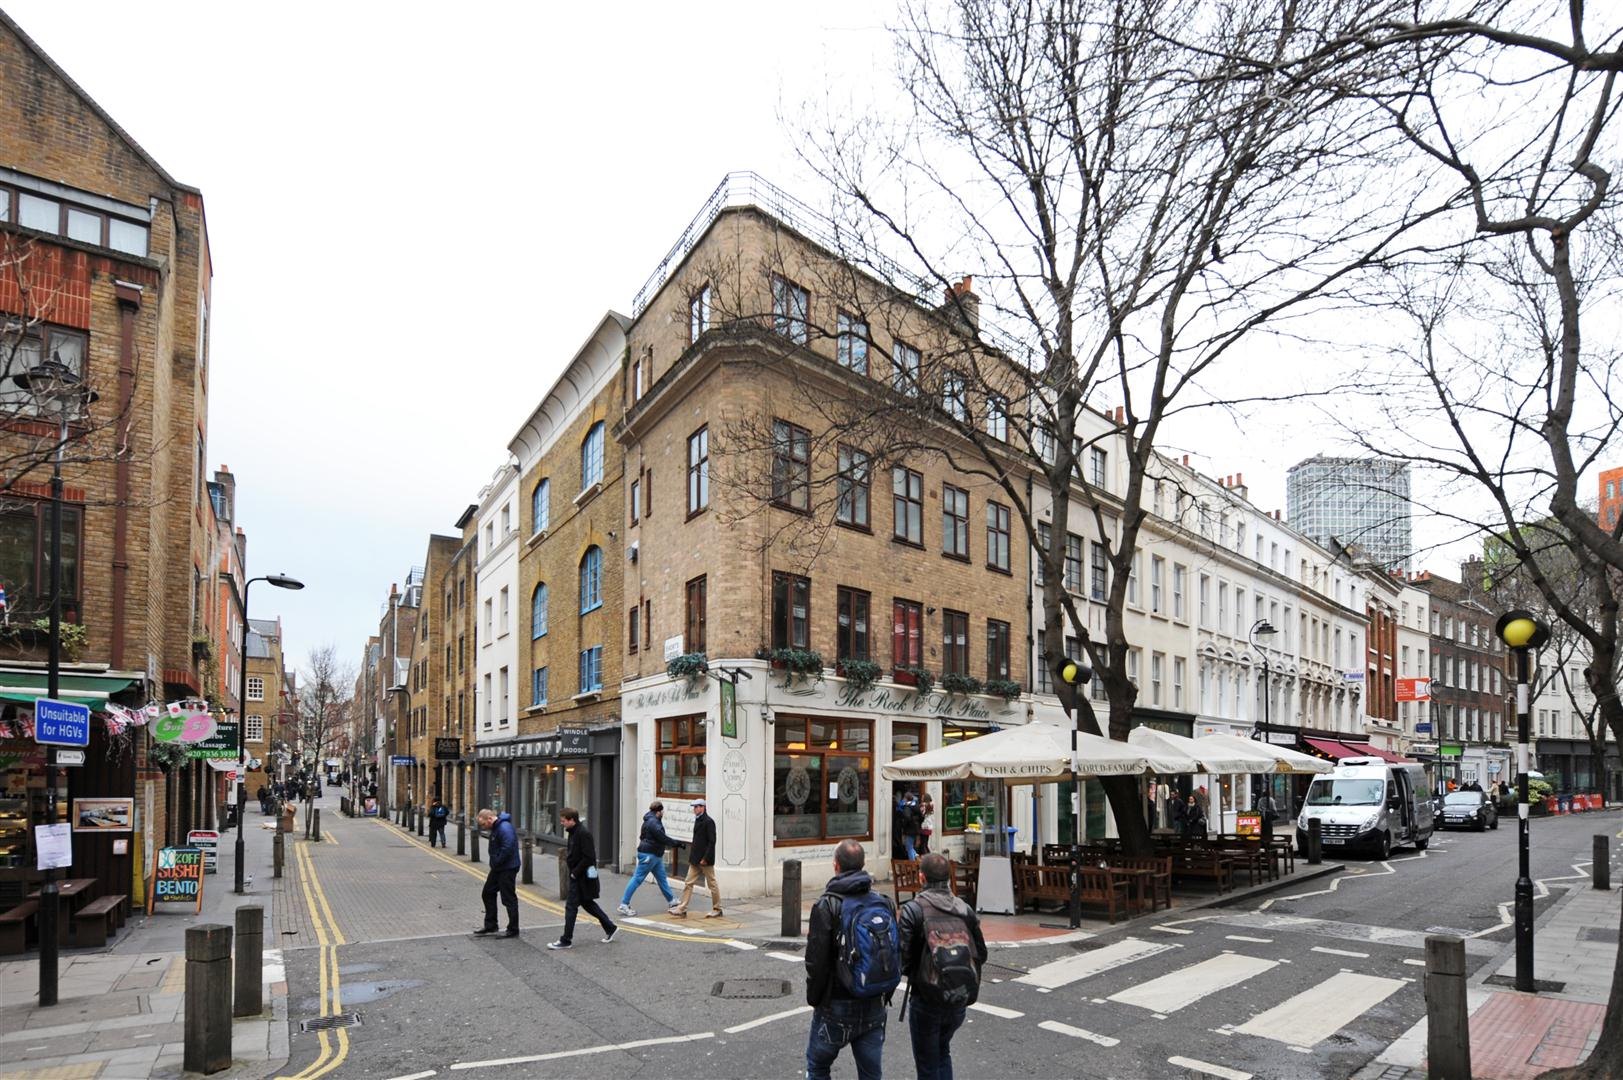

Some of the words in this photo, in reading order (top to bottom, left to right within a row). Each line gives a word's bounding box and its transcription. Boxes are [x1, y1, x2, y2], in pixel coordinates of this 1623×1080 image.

[835, 686, 864, 707] The
[869, 686, 907, 710] Rock
[913, 695, 927, 711] &
[927, 694, 953, 714] Sole
[957, 699, 990, 718] Plaice
[40, 706, 86, 724] Unsuitable
[43, 722, 56, 736] for
[59, 724, 83, 739] HGVs
[197, 741, 227, 750] Massage
[984, 766, 1006, 775] FISH
[1009, 765, 1017, 774] &
[1020, 764, 1051, 774] CHIPS
[1238, 818, 1257, 826] SALE
[158, 865, 199, 878] SUSHI
[157, 881, 198, 894] BENTO
